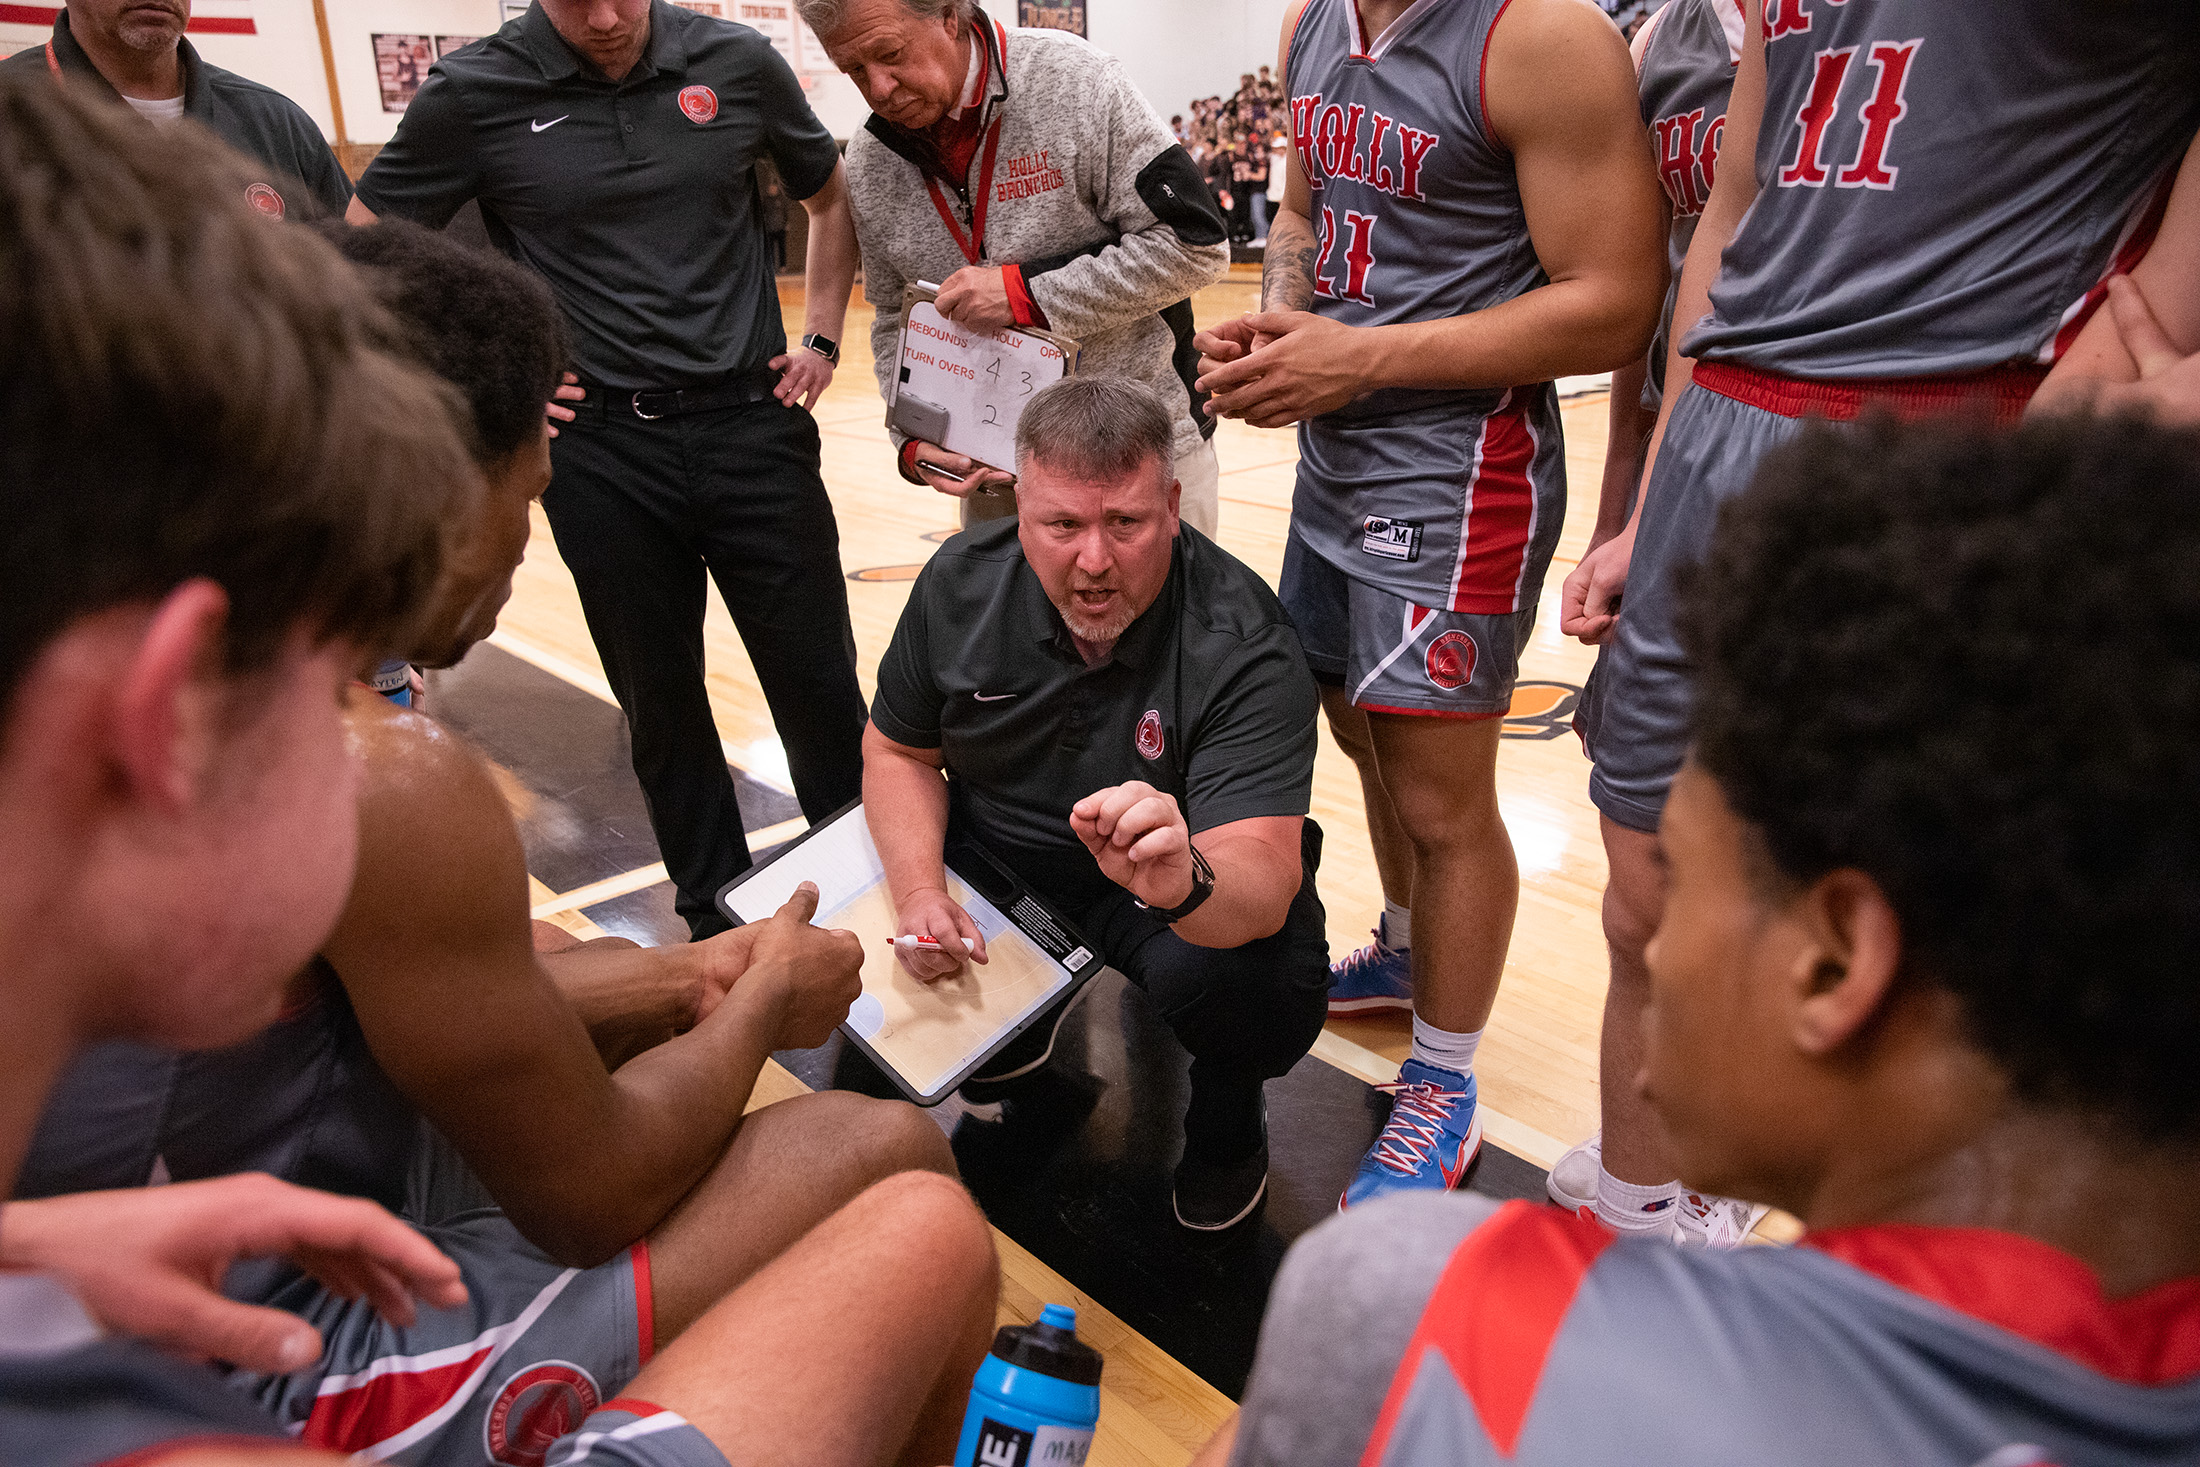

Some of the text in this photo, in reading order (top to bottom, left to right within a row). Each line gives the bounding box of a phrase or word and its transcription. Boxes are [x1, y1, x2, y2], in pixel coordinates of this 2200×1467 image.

[1778, 38, 1925, 190] 11
[1008, 150, 1048, 178] HOLLY
[1291, 92, 1440, 203] HOLLY
[997, 169, 1064, 202] BRONCHOS
[1314, 203, 1378, 308] 21
[909, 319, 1063, 361] REBOUNDS HOLLY OPP
[905, 347, 975, 380] TURN OVERS
[986, 357, 1033, 396] 4 3
[981, 404, 1002, 427] 2
[1393, 527, 1408, 543] M
